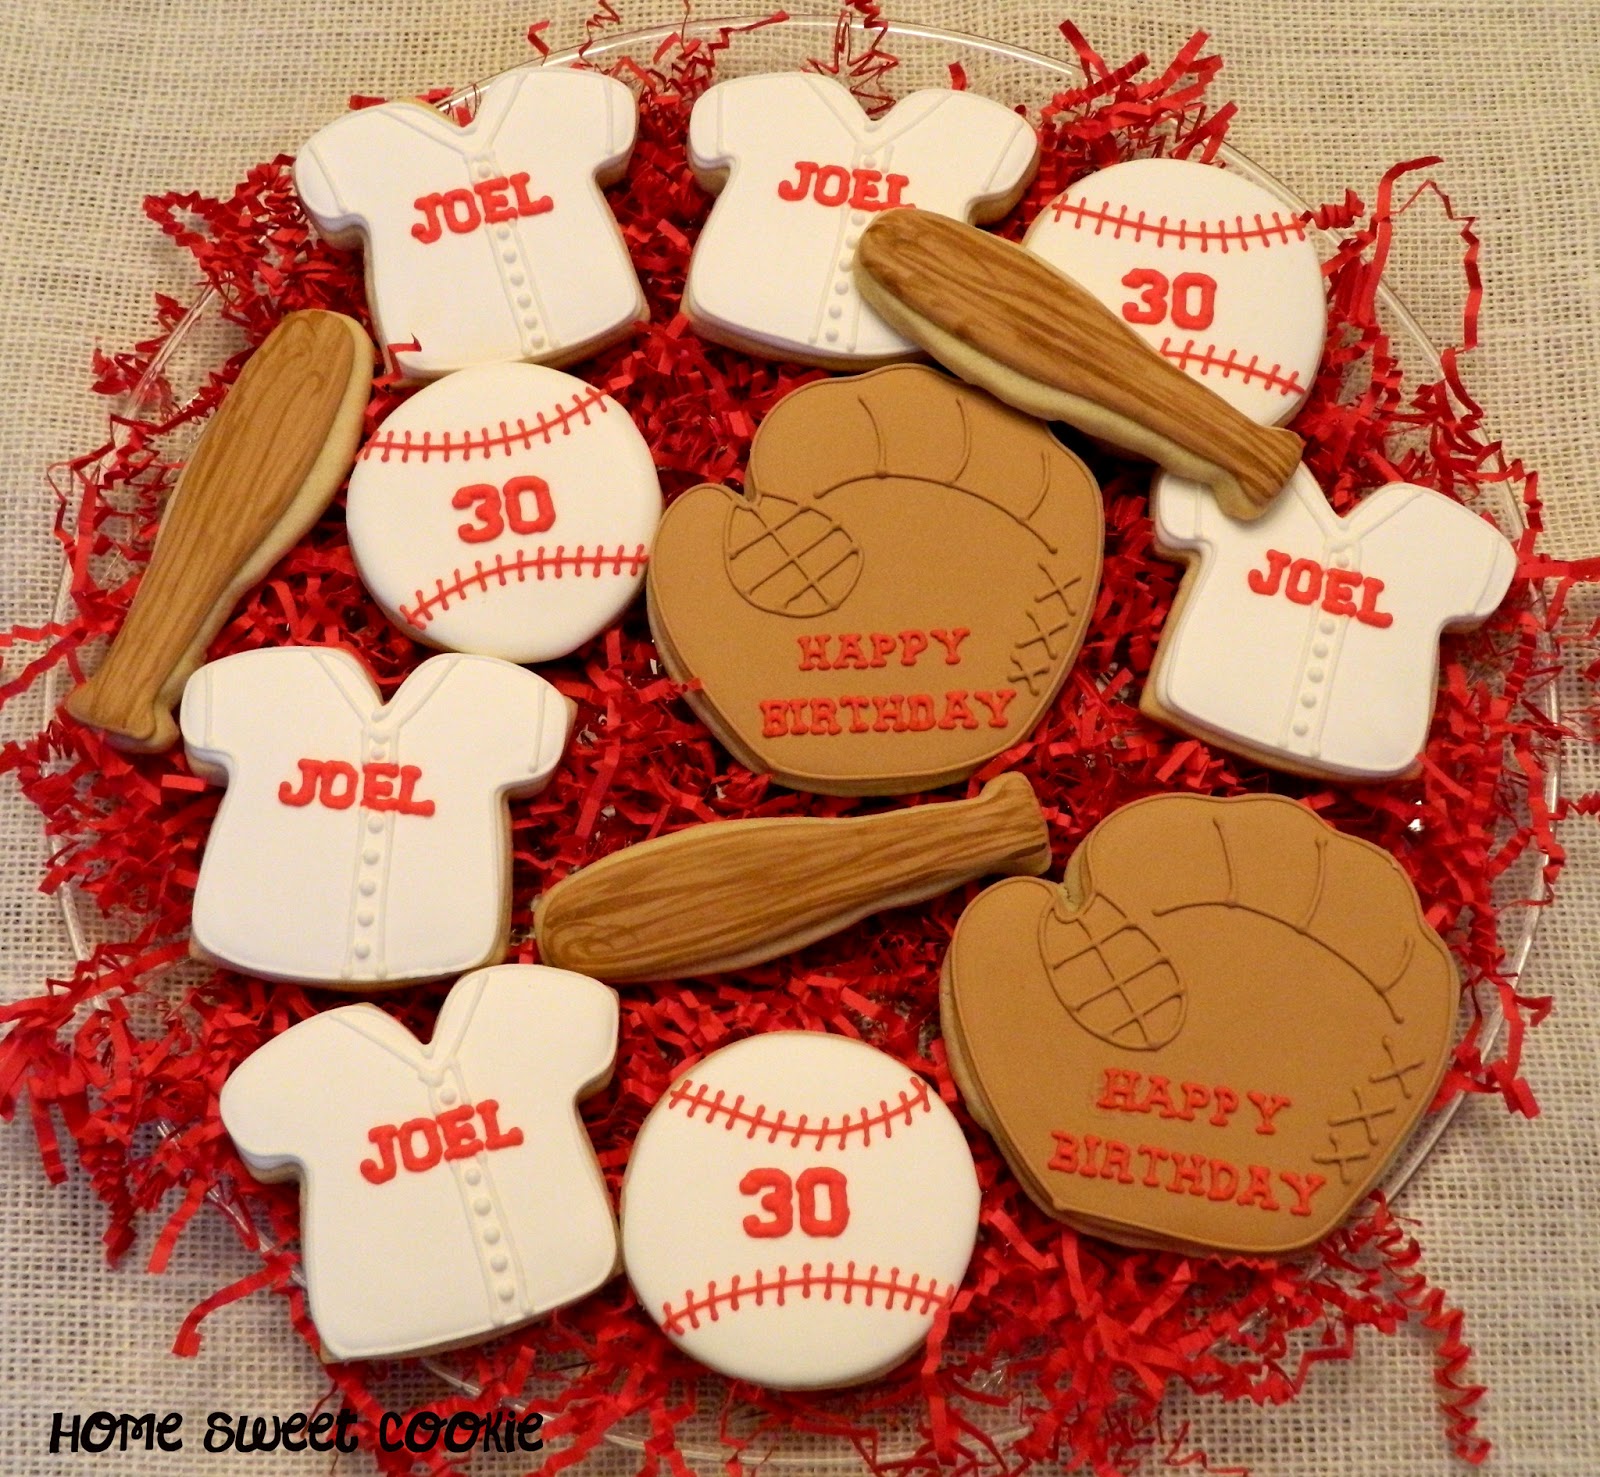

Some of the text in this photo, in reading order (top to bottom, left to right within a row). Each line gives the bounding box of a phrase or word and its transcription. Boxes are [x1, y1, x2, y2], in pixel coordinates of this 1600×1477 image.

[411, 172, 554, 244] JOEL
[778, 161, 916, 212] JOEL
[1121, 268, 1217, 331] 30
[451, 475, 556, 544] 30
[1248, 549, 1393, 628] JOEL
[797, 627, 970, 671] HAPPY
[759, 689, 1017, 738] BIRTHDAY
[278, 759, 436, 817] JOEL
[1096, 1067, 1292, 1135] HAPPY
[359, 1100, 524, 1185] JOEL
[1047, 1130, 1327, 1216] BIRTHDAY
[739, 1167, 851, 1239] 30
